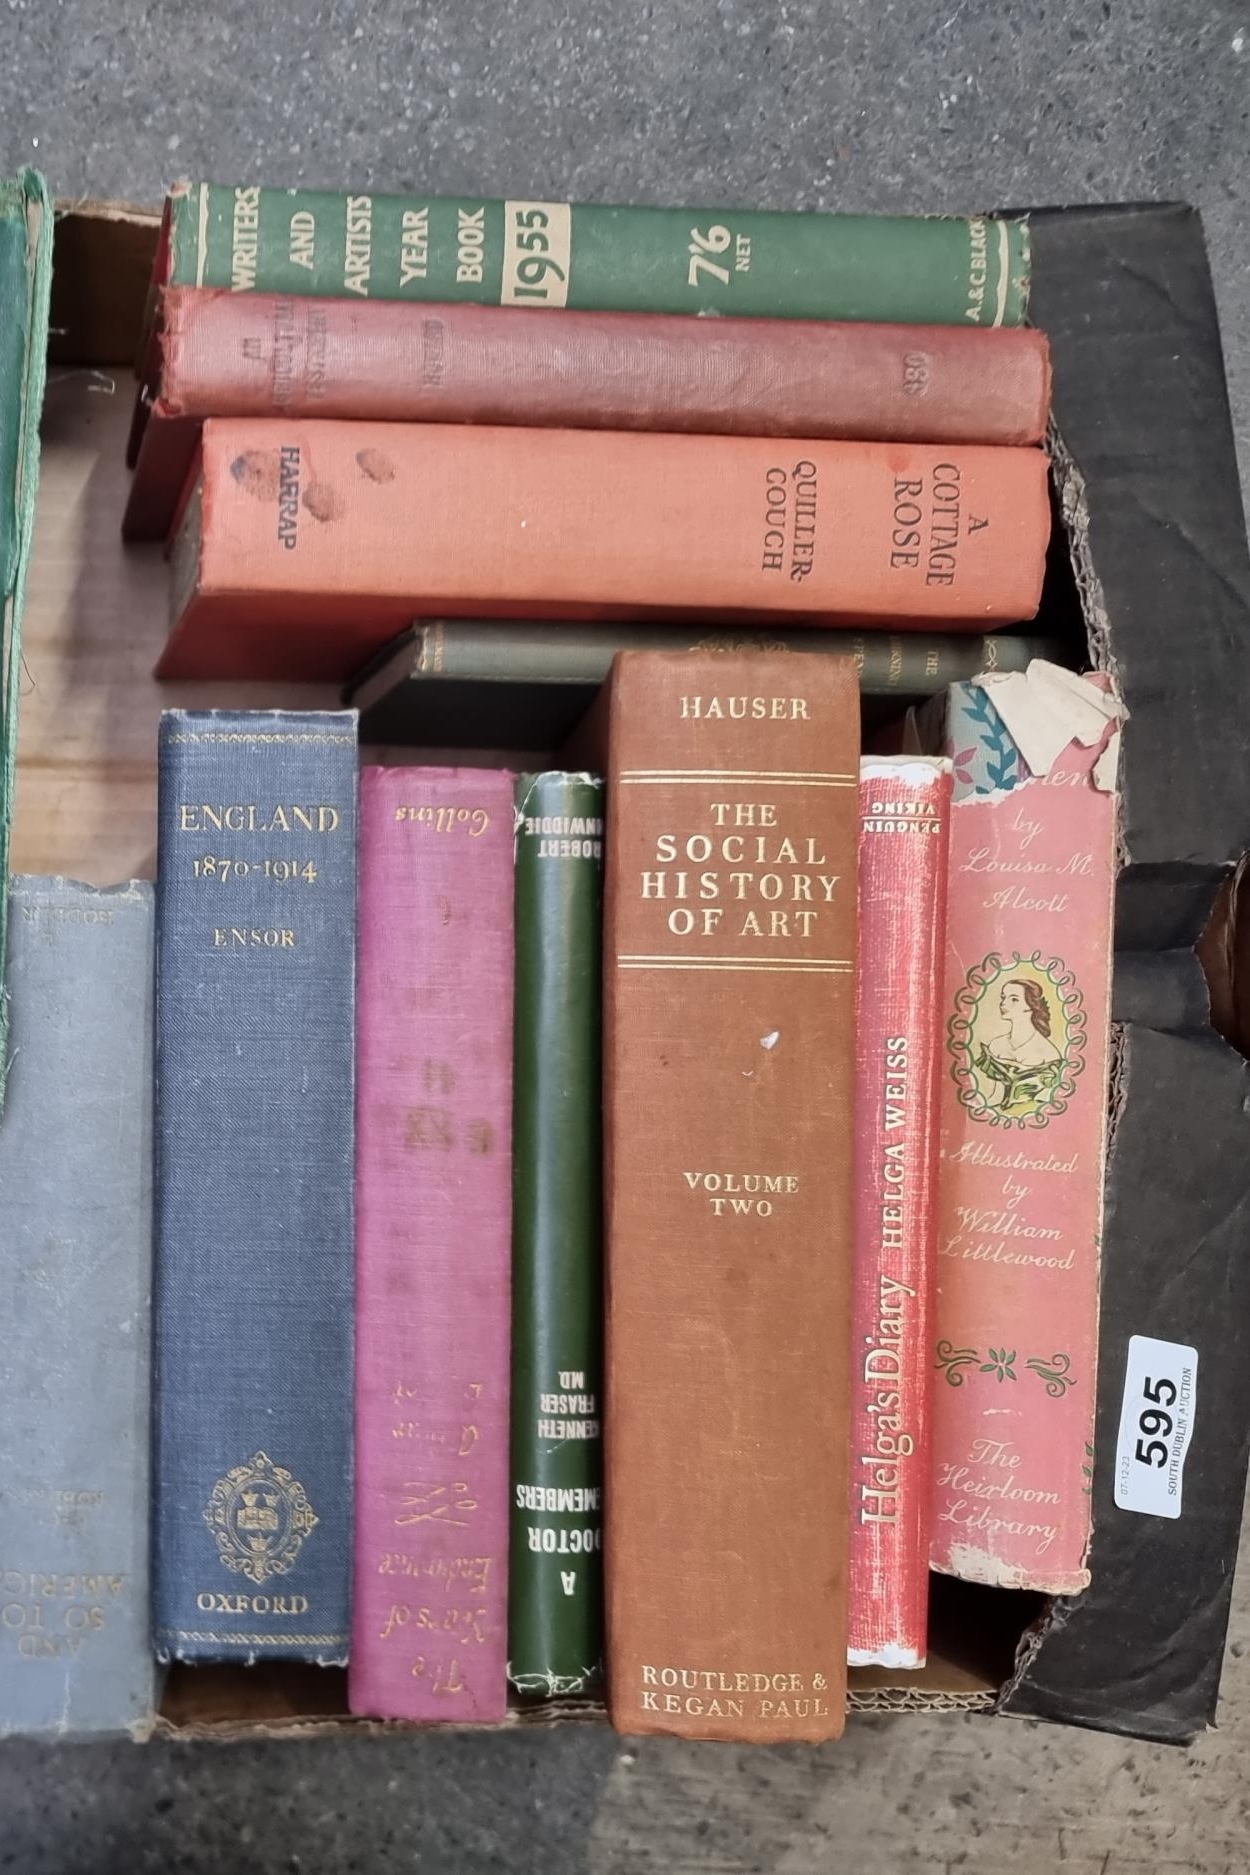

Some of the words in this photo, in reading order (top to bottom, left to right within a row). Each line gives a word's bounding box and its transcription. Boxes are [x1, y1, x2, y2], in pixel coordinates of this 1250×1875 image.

[231, 186, 261, 292] WRITERS
[287, 211, 316, 270] AND
[343, 195, 373, 296] ARTISTS
[399, 207, 429, 287] YEAR
[456, 206, 485, 283] BOOK
[513, 209, 565, 299] 1955
[735, 234, 750, 271] NET
[278, 446, 300, 549] HARRAP
[762, 467, 787, 572] COUCH
[890, 478, 923, 569] ROSE
[926, 462, 960, 586] COTTAGE
[968, 514, 989, 535] A
[680, 696, 810, 720] HAUSER
[180, 805, 339, 832] ENGLAND
[394, 806, 489, 837] Collins
[710, 803, 777, 827] THE
[872, 802, 935, 815] VIKING
[864, 821, 940, 833] PENGUIN
[1008, 808, 1044, 850] by
[538, 839, 601, 858] ROBERT
[656, 834, 826, 864] SOCIAL
[959, 848, 1051, 873] Louisa
[1056, 853, 1095, 876] M.
[193, 856, 317, 883] 1870-1914
[641, 872, 840, 901] HISTORY
[983, 885, 1070, 913] Alcott
[214, 928, 295, 947] ENSOR
[668, 908, 723, 936] OF
[739, 910, 818, 937] ART
[885, 1036, 908, 1132] WEISS
[948, 1141, 1078, 1174] Illustrated
[683, 1172, 799, 1194] VOLUME
[880, 1142, 906, 1250] HELGA
[1002, 1175, 1030, 1208] by
[710, 1198, 772, 1217] TWO
[955, 1204, 1064, 1241] William
[941, 1240, 1076, 1271] Littlewood
[865, 1275, 915, 1386] Diary
[540, 1394, 594, 1414] FRASER
[1135, 1376, 1177, 1468] 595
[1173, 1418, 1187, 1457] DUBLIN
[862, 1386, 913, 1527] Helga's
[967, 1438, 1023, 1469] The
[937, 1461, 1061, 1504] Heirloom
[1168, 1461, 1180, 1496] SOUTH
[938, 1499, 1059, 1556] Library
[561, 1570, 576, 1596] A
[1, 1602, 45, 1631] TO
[64, 1605, 107, 1632] SO
[197, 1593, 308, 1614] OXFORD
[380, 1605, 411, 1638] of
[642, 1665, 804, 1692] ROUTLEDGE
[812, 1673, 828, 1690] &
[641, 1691, 744, 1718] KEGAN
[759, 1699, 828, 1719] PAUL
